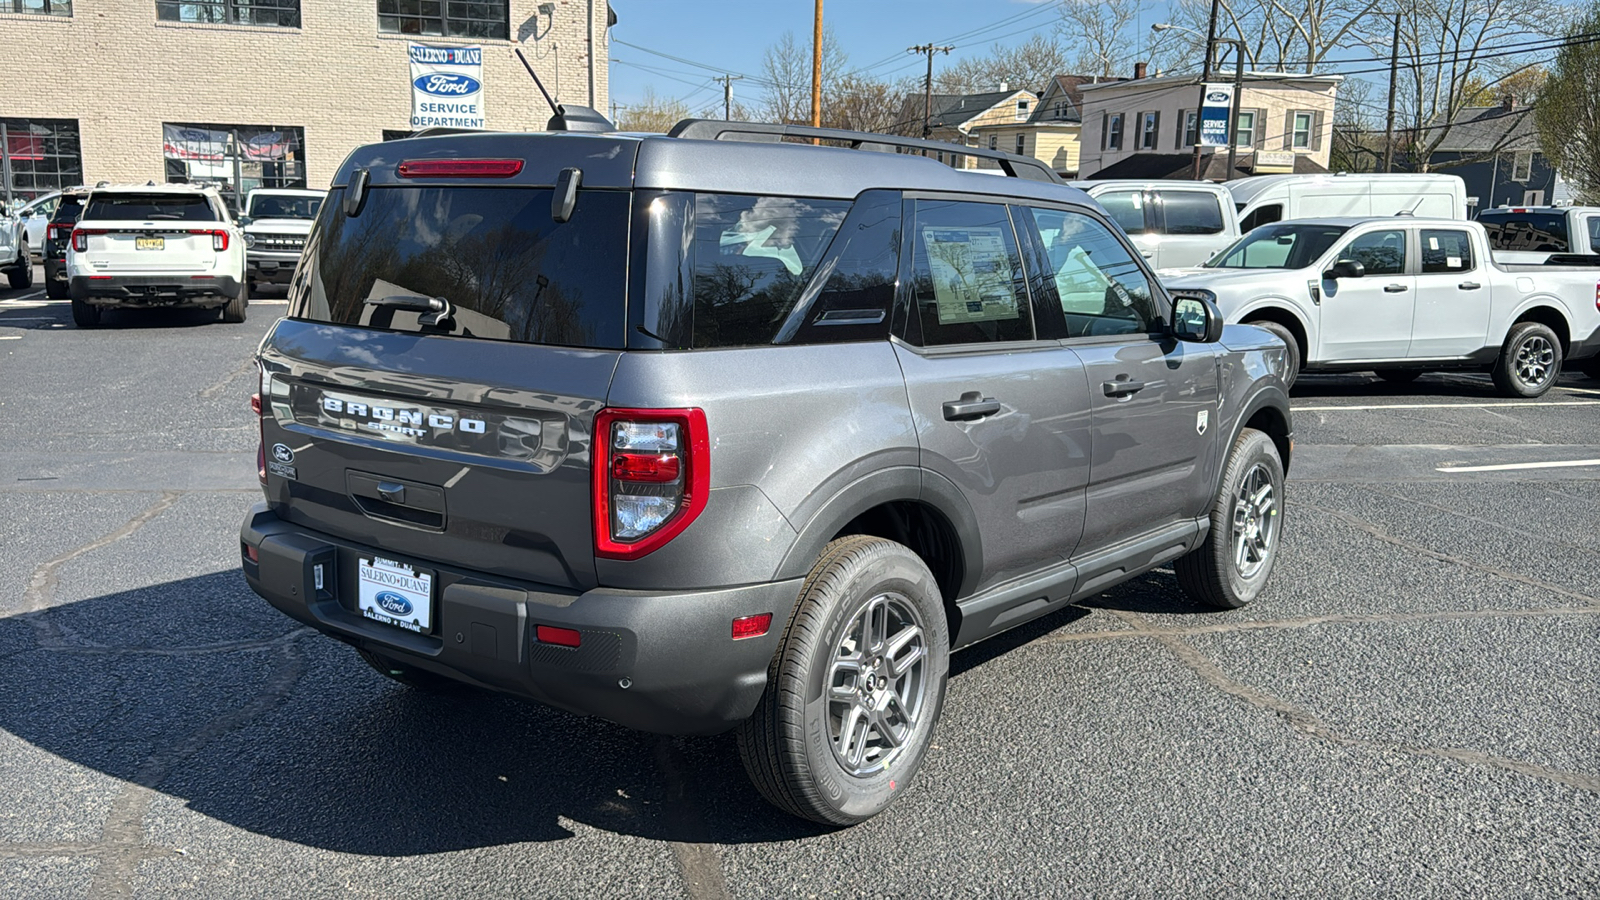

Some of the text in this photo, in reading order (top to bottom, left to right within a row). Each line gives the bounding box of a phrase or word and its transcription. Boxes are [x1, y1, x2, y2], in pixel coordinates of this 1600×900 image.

[411, 47, 481, 64] SALERNO DUANE
[426, 75, 469, 93] Ford
[420, 102, 477, 114] SERVICE
[413, 116, 485, 128] DEPARTMENT
[1203, 119, 1226, 129] SERVICE
[324, 398, 485, 434] BRONCO
[367, 421, 427, 437] SPORT
[361, 567, 429, 593] SALERNO DUANE
[382, 594, 406, 613] Ford
[363, 611, 421, 632] SALERNO DUANE
